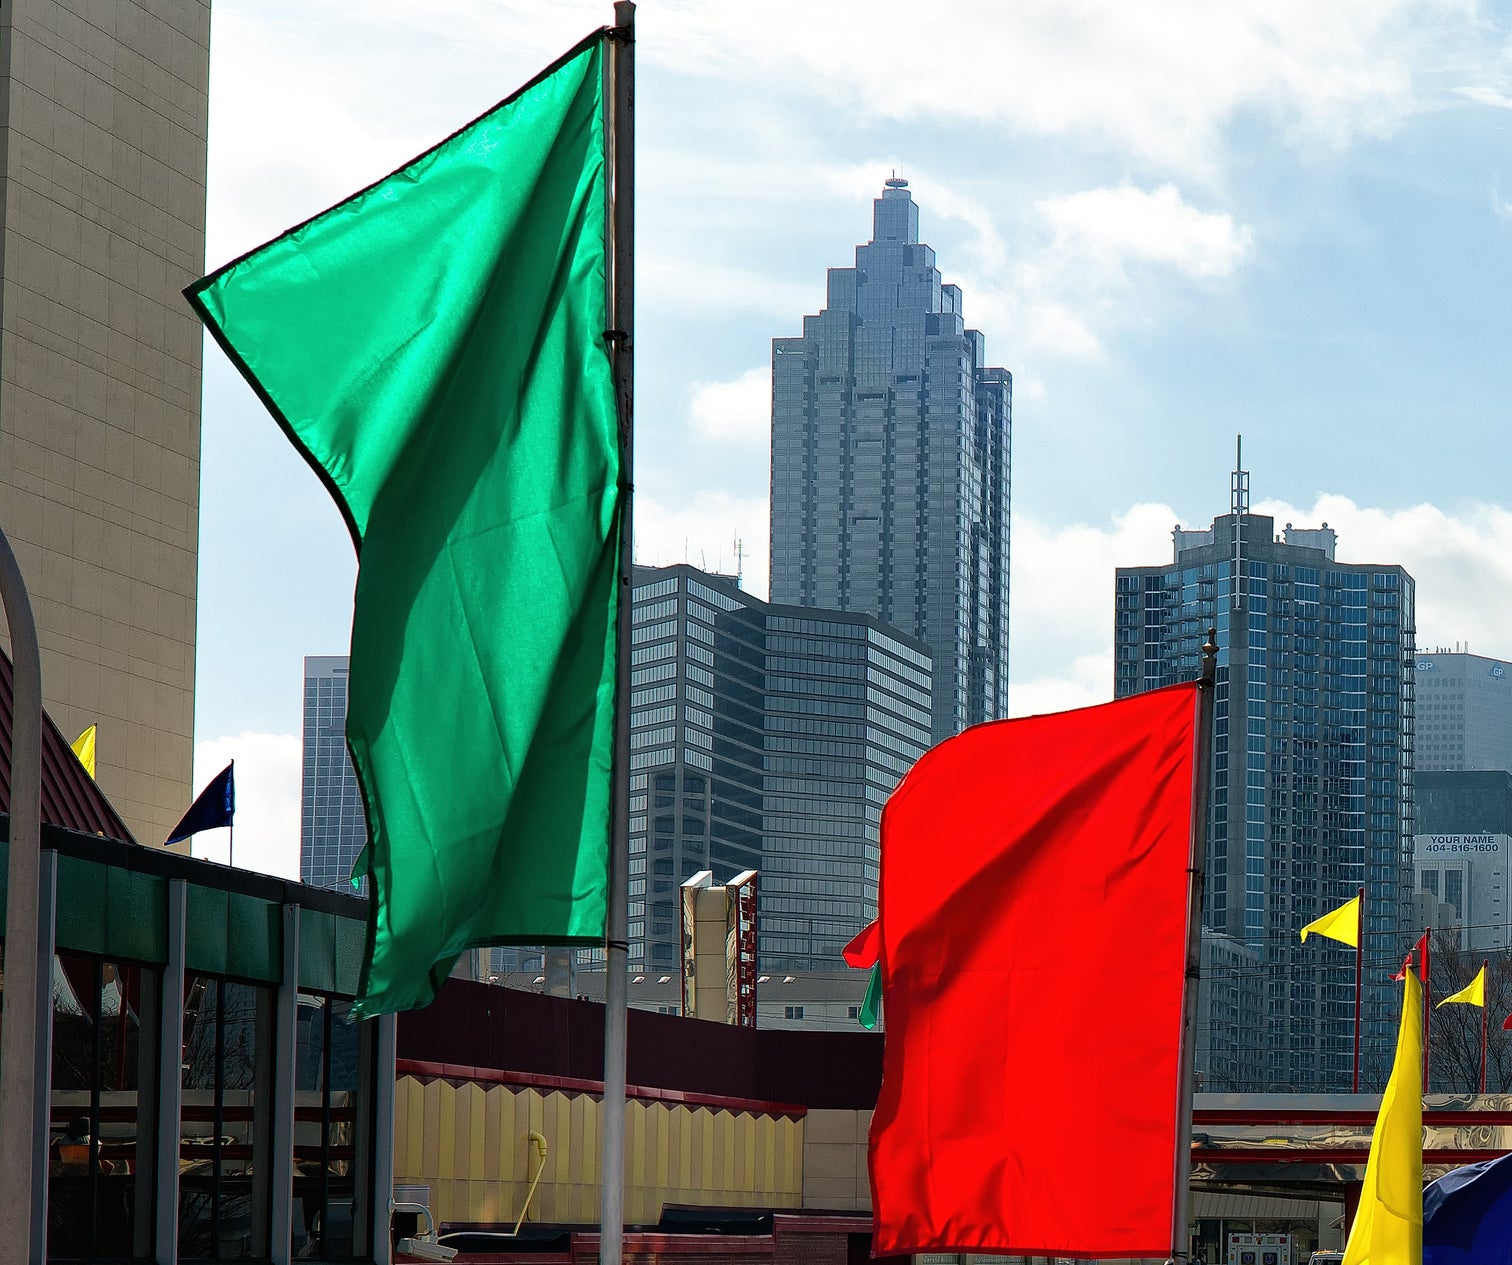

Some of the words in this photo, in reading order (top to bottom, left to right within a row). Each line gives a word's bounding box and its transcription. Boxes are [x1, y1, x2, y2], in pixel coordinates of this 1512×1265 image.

[1416, 662, 1434, 671] GP
[1493, 668, 1504, 677] GP
[1430, 836, 1460, 844] YOUR
[1463, 836, 1495, 844] NAME
[1425, 844, 1499, 852] 404-816-1600
